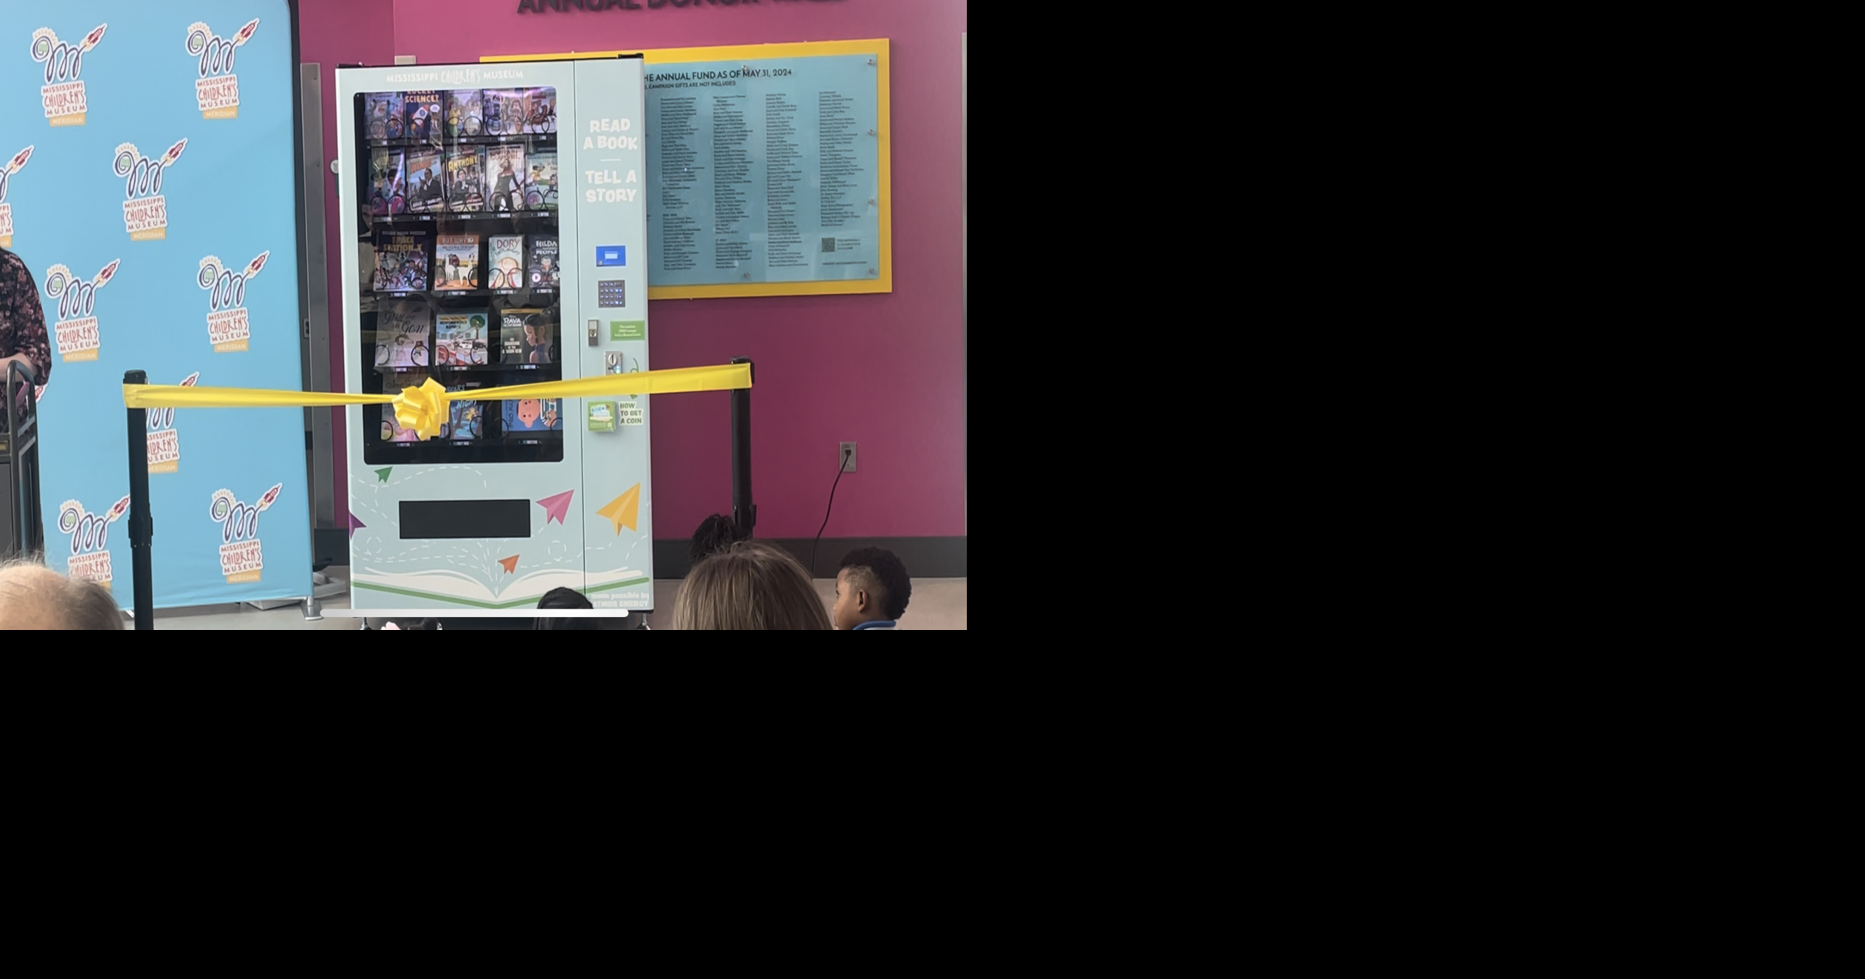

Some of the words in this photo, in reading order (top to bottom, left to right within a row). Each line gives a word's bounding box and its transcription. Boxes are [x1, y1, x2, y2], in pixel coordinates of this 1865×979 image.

[386, 72, 438, 82] MISSISSIPPI
[441, 68, 481, 84] CHILDREN'S
[484, 70, 524, 80] MUSEUM
[655, 72, 690, 81] ANNUAL
[692, 71, 716, 80] FUND
[717, 70, 727, 78] AS
[729, 70, 742, 78] OF
[742, 69, 761, 78] MAY
[762, 70, 771, 78] 31,
[773, 68, 792, 77] 2024
[197, 76, 236, 87] MISSISSIPPI
[43, 83, 83, 94] MISSISSIPPI
[198, 83, 238, 101] CHILDREN'S
[44, 90, 85, 107] CHILDREN'S
[200, 98, 238, 109] MUSEUM
[46, 106, 86, 115] MUSEUM
[590, 118, 630, 132] READ
[584, 138, 594, 150] A
[598, 136, 638, 150] BOOK
[448, 155, 477, 172] ANTHONY
[585, 170, 621, 184] TELL
[626, 170, 638, 183] A
[586, 188, 638, 203] STORY
[124, 197, 164, 208] MISSISSIPPI
[126, 204, 165, 222] CHILDREN'S
[128, 220, 166, 230] MUSEUM
[496, 239, 520, 249] DORY
[536, 240, 558, 248] HILDA
[208, 310, 246, 320] MISSISSIPPI
[56, 318, 96, 330] MISSISSIPPI
[210, 316, 248, 334] CHILDREN'S
[57, 325, 98, 343] CHILDREN'S
[212, 332, 249, 342] MUSEUM
[60, 341, 98, 351] MUSEUM
[148, 452, 178, 462] USEUM
[220, 540, 259, 552] MISSISSIPPI
[69, 552, 108, 564] MISSISSIPPI
[222, 547, 260, 566] CHILDREN'S
[224, 562, 262, 573] MUSEUM
